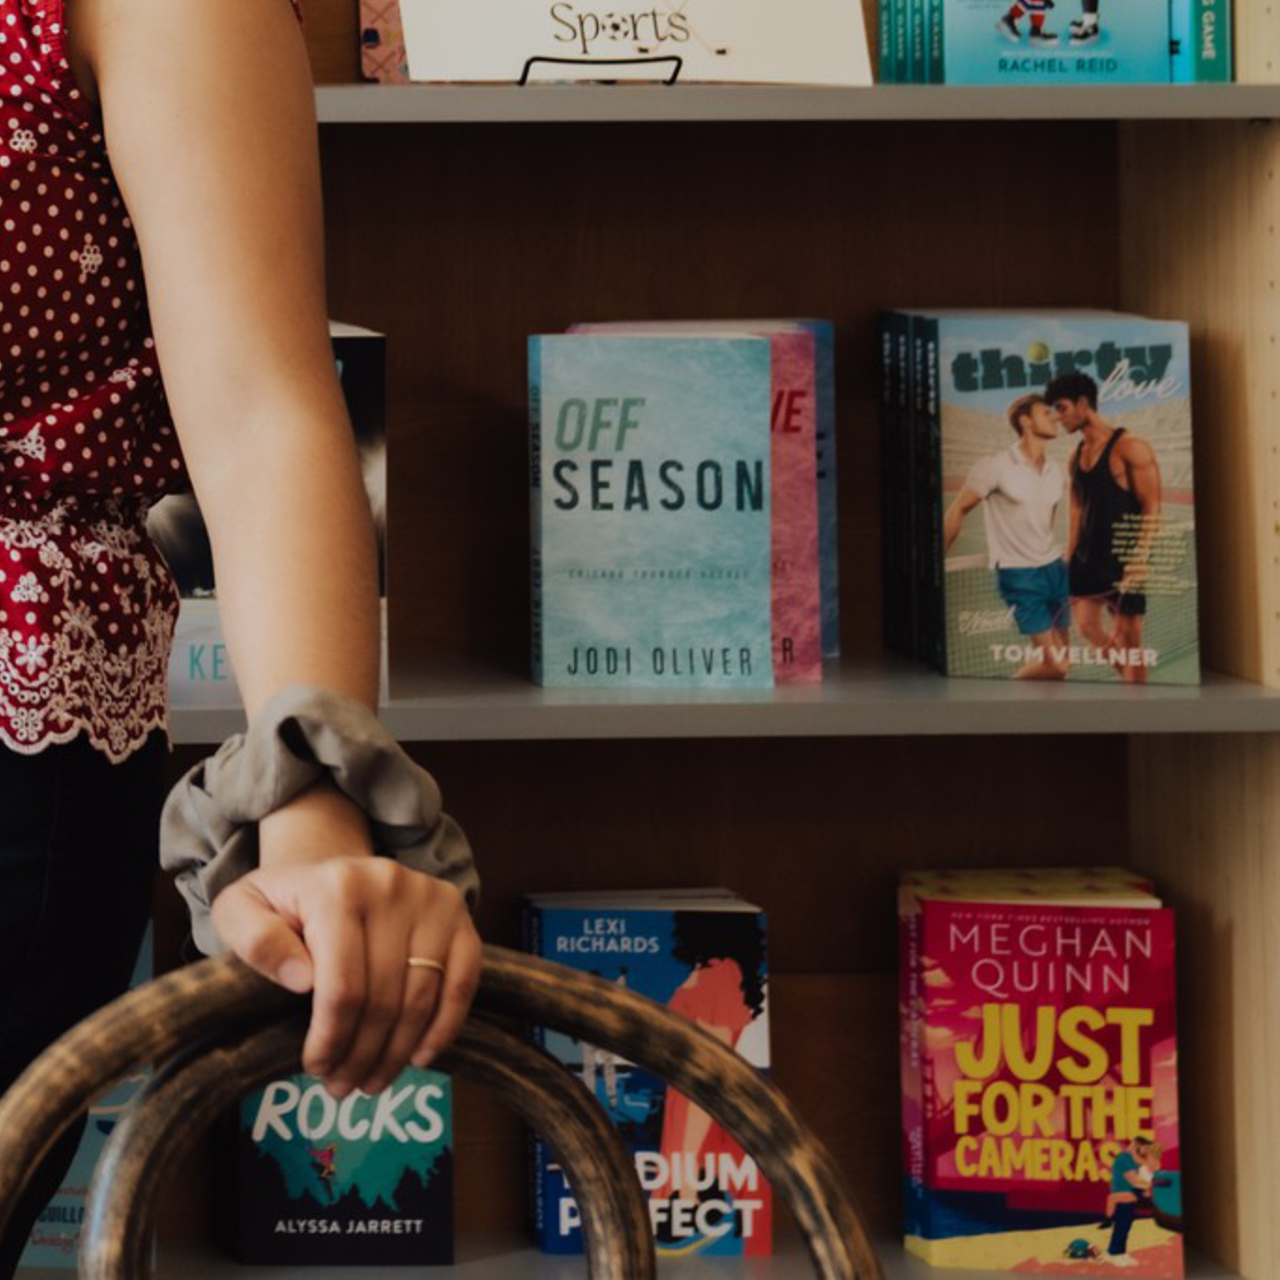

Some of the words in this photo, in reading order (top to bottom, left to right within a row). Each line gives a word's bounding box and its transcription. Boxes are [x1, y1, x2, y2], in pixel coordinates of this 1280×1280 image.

[1201, 10, 1216, 61] GAME
[998, 58, 1069, 74] RACHEL
[1075, 57, 1119, 73] REID
[1095, 357, 1183, 403] love
[553, 397, 647, 453] OFF
[552, 458, 765, 513] SEASON
[566, 646, 632, 676] JODI
[652, 646, 753, 677] OLIVER
[988, 643, 1044, 666] TOM
[1051, 644, 1158, 668] VELLNER
[556, 935, 661, 954] RICHARDS
[583, 918, 626, 936] LEXI
[949, 922, 1153, 960] MEGHAN
[971, 957, 1131, 998] QUINN
[953, 1002, 1155, 1086] JUST
[250, 1080, 444, 1143] ROCKS
[953, 1079, 1055, 1138] FOR
[1059, 1084, 1156, 1141] THE
[954, 1134, 1123, 1183] CAMERAS
[274, 1219, 341, 1235] ALYSSA
[346, 1219, 424, 1235] JARRETT
[558, 1197, 764, 1238] PFECT
